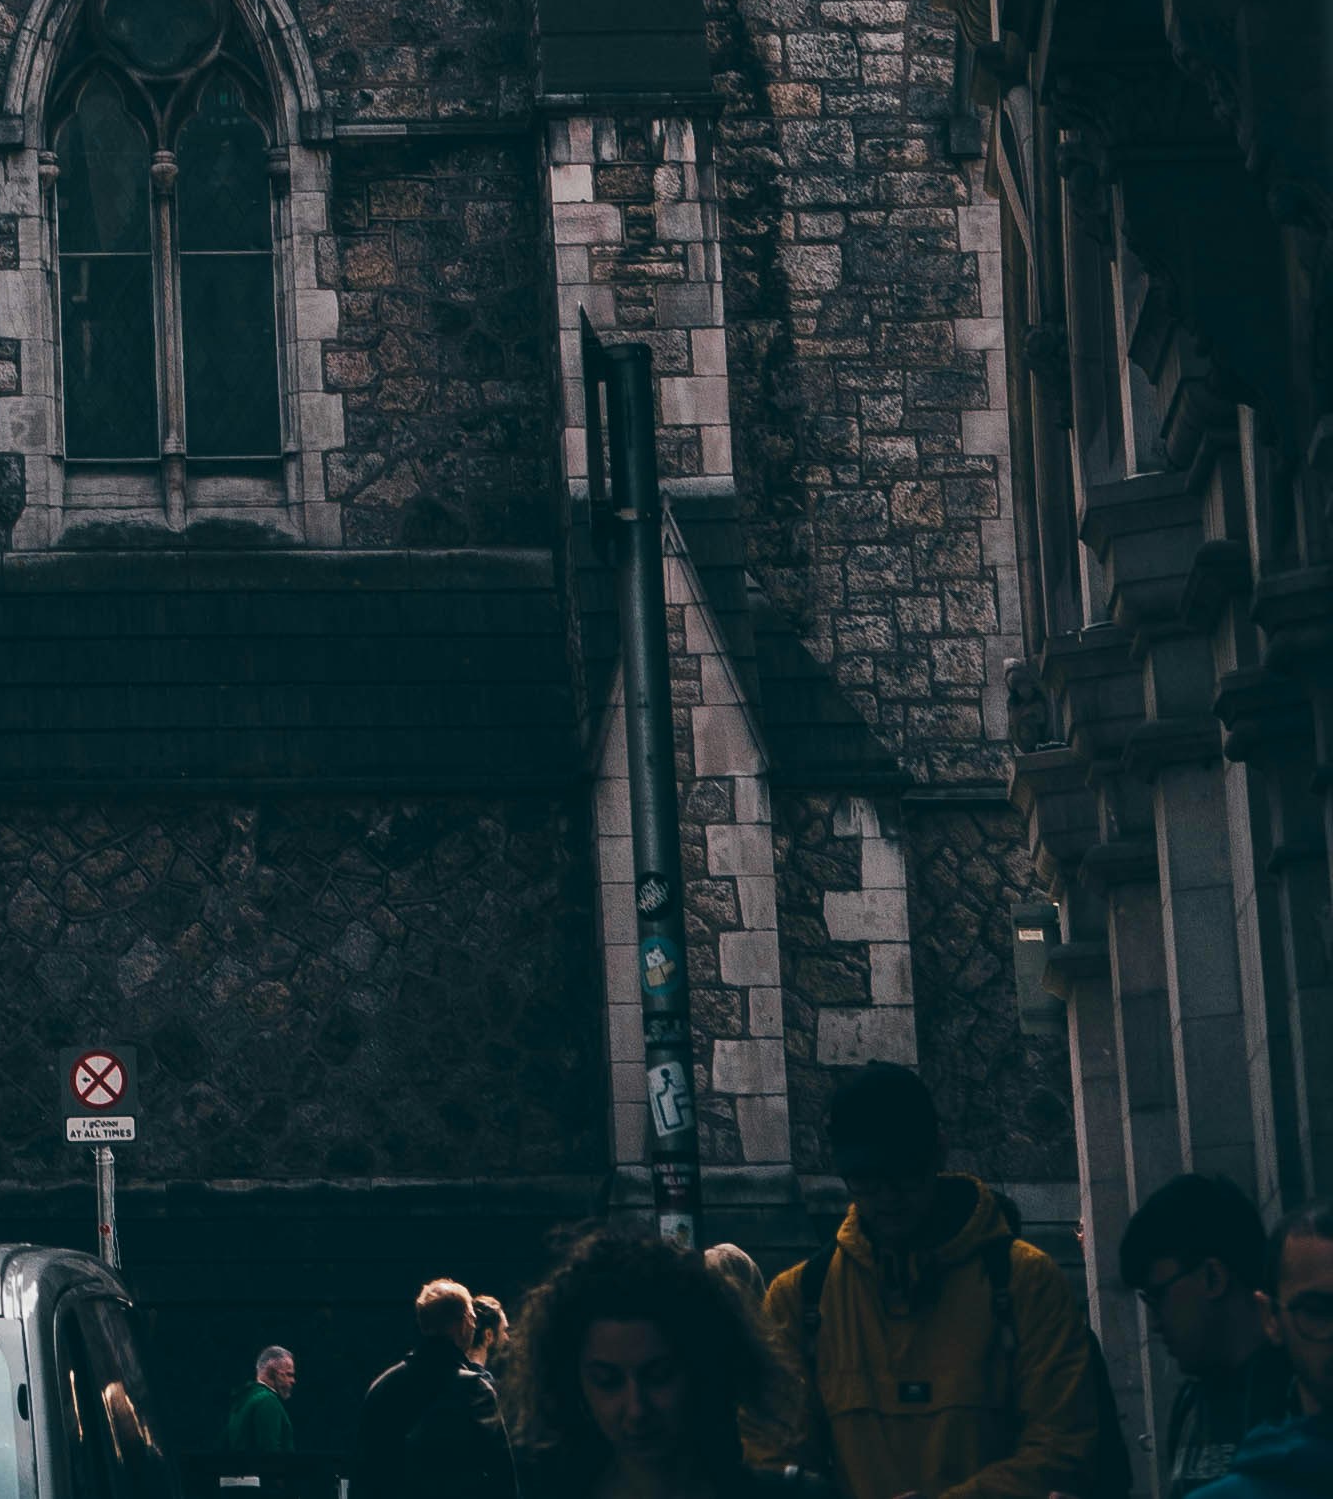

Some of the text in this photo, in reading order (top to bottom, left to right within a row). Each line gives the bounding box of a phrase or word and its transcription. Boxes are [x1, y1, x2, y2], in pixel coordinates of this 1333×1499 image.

[70, 1129, 132, 1138] AT ALL TIMES
